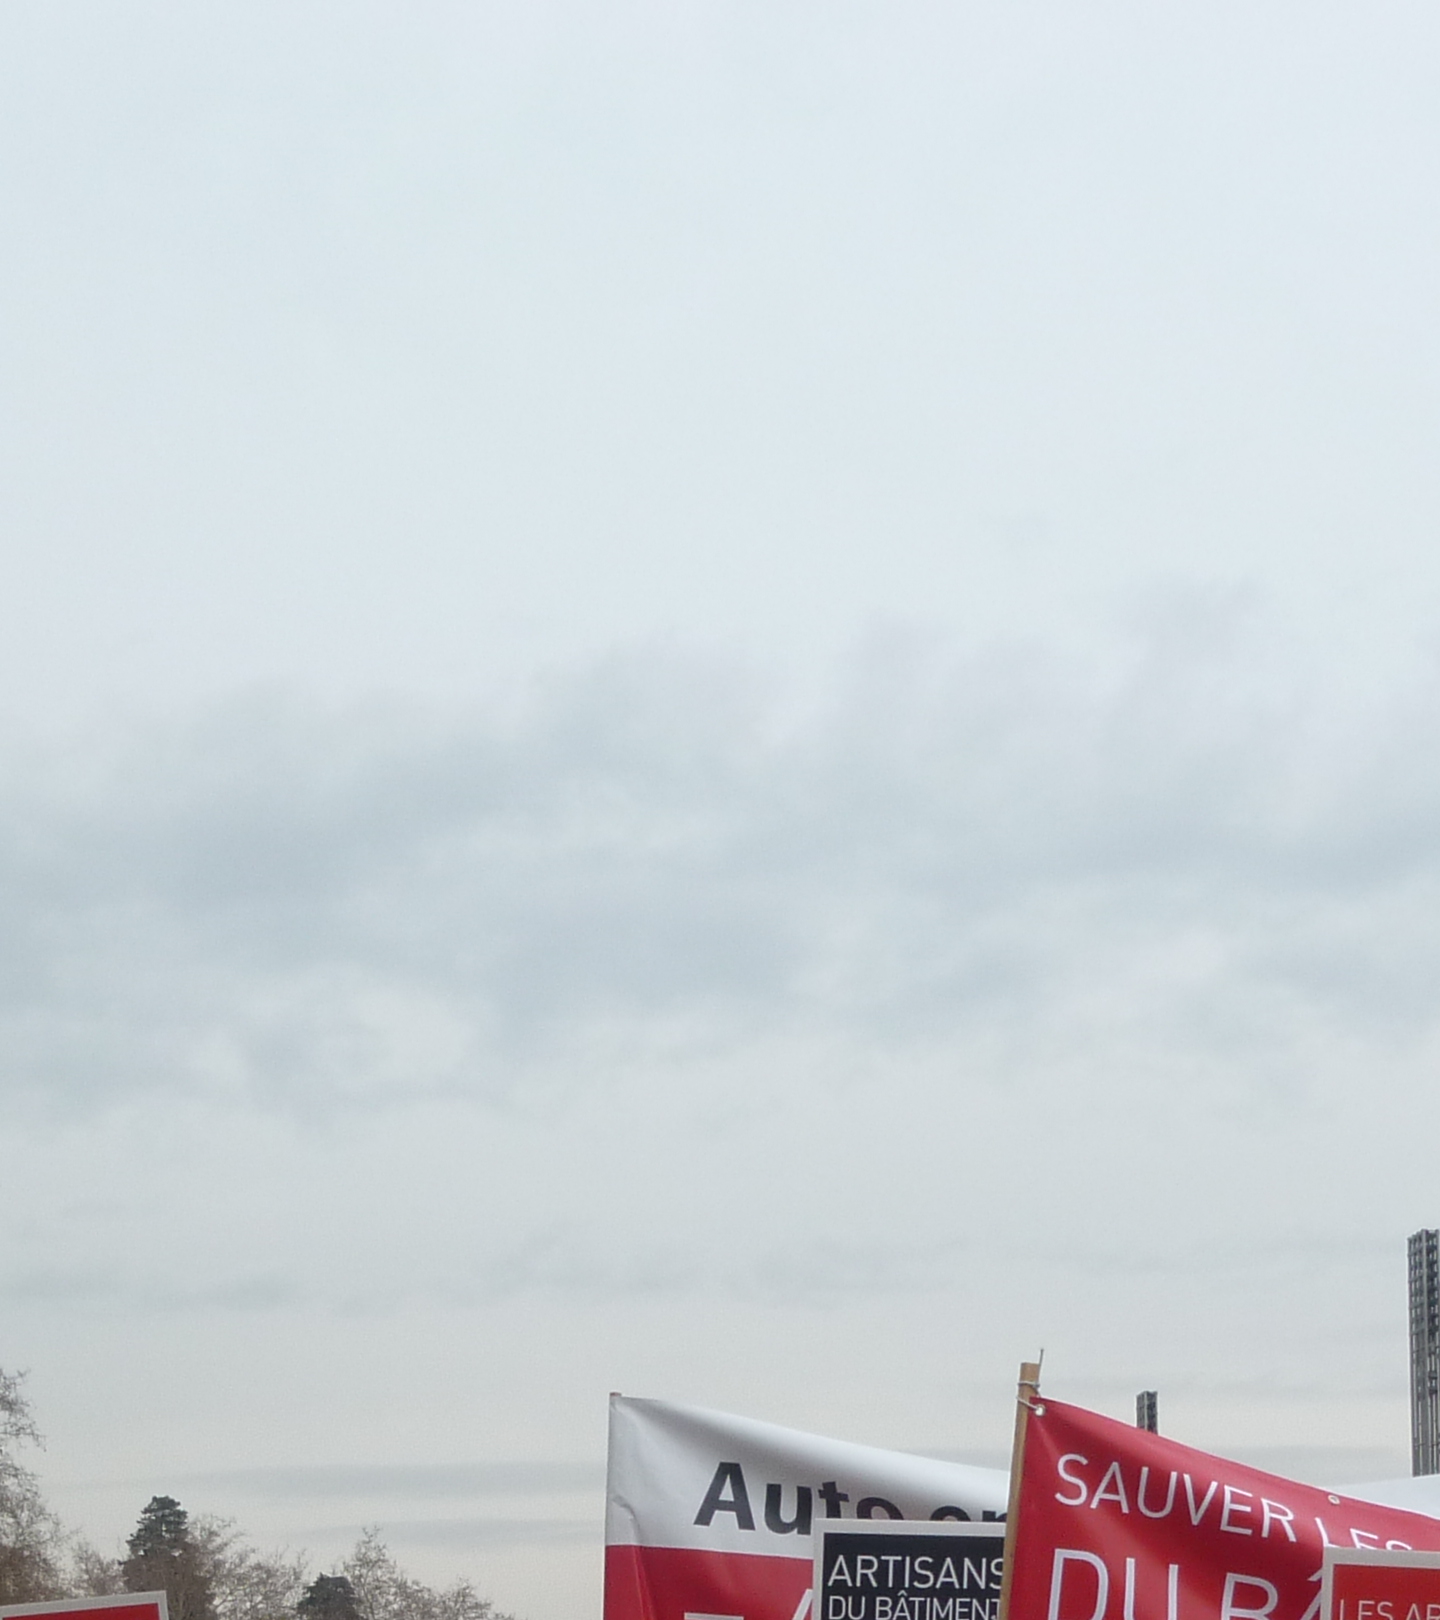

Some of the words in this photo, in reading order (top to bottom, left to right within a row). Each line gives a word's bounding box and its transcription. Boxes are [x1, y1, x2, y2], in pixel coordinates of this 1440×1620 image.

[1054, 1453, 1297, 1542] SAUVER
[828, 1554, 1003, 1590] ARTISANS
[828, 1595, 866, 1620] DU
